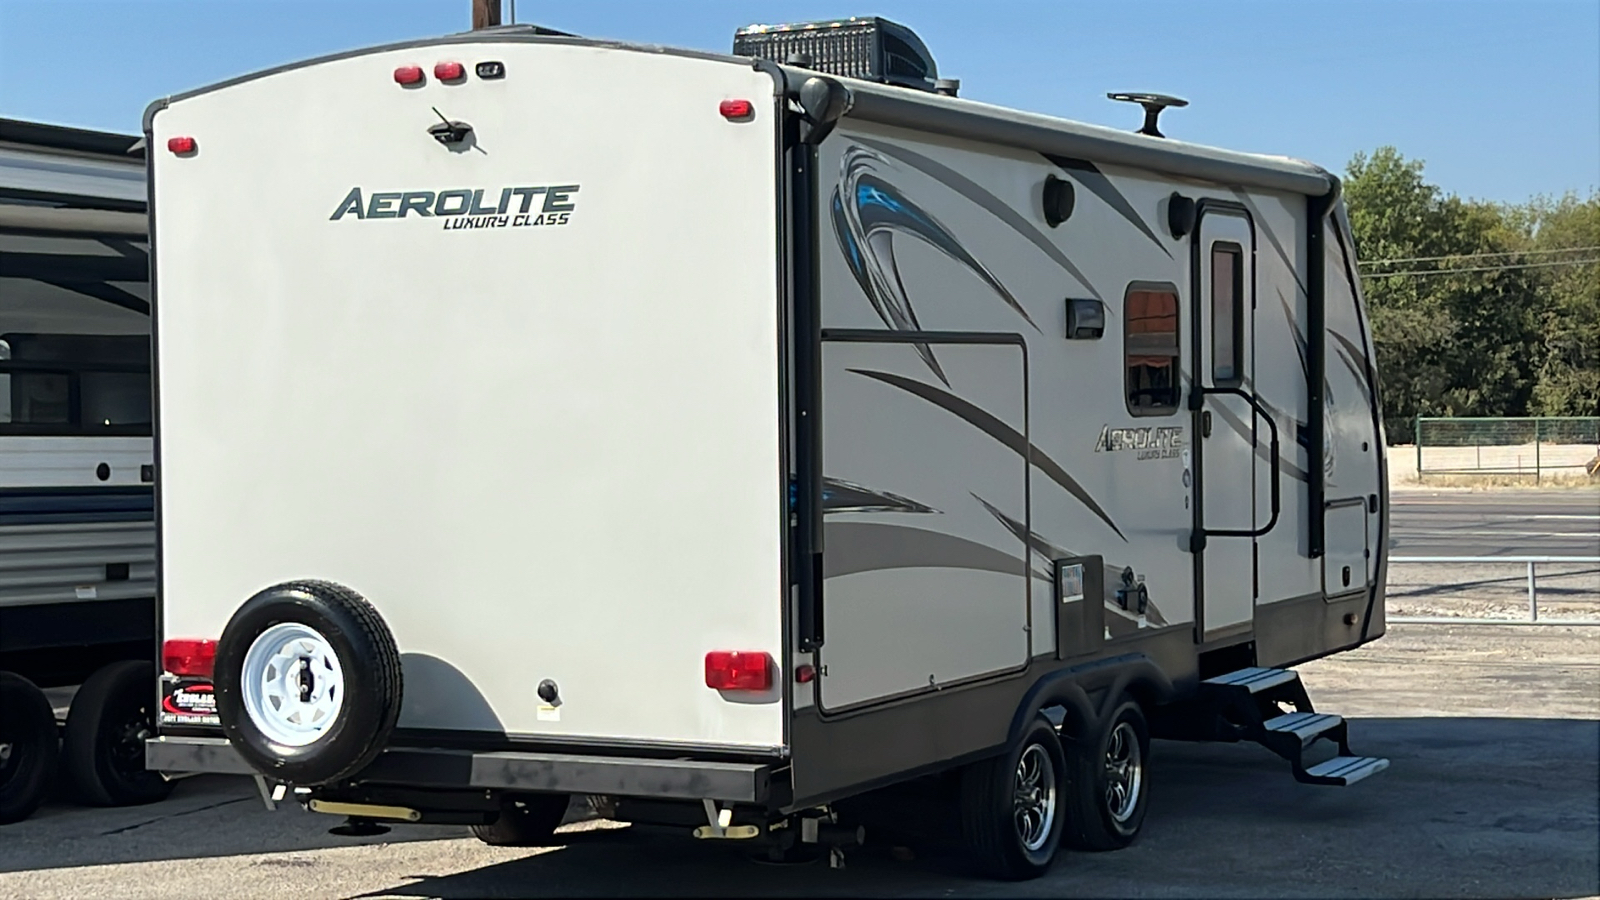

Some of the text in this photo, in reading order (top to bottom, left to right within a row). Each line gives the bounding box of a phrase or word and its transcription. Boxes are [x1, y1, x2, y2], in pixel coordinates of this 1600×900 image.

[329, 184, 580, 221] AEROLITE
[443, 213, 571, 230] LUXURY CLASS
[1095, 424, 1183, 452] AEROLITE
